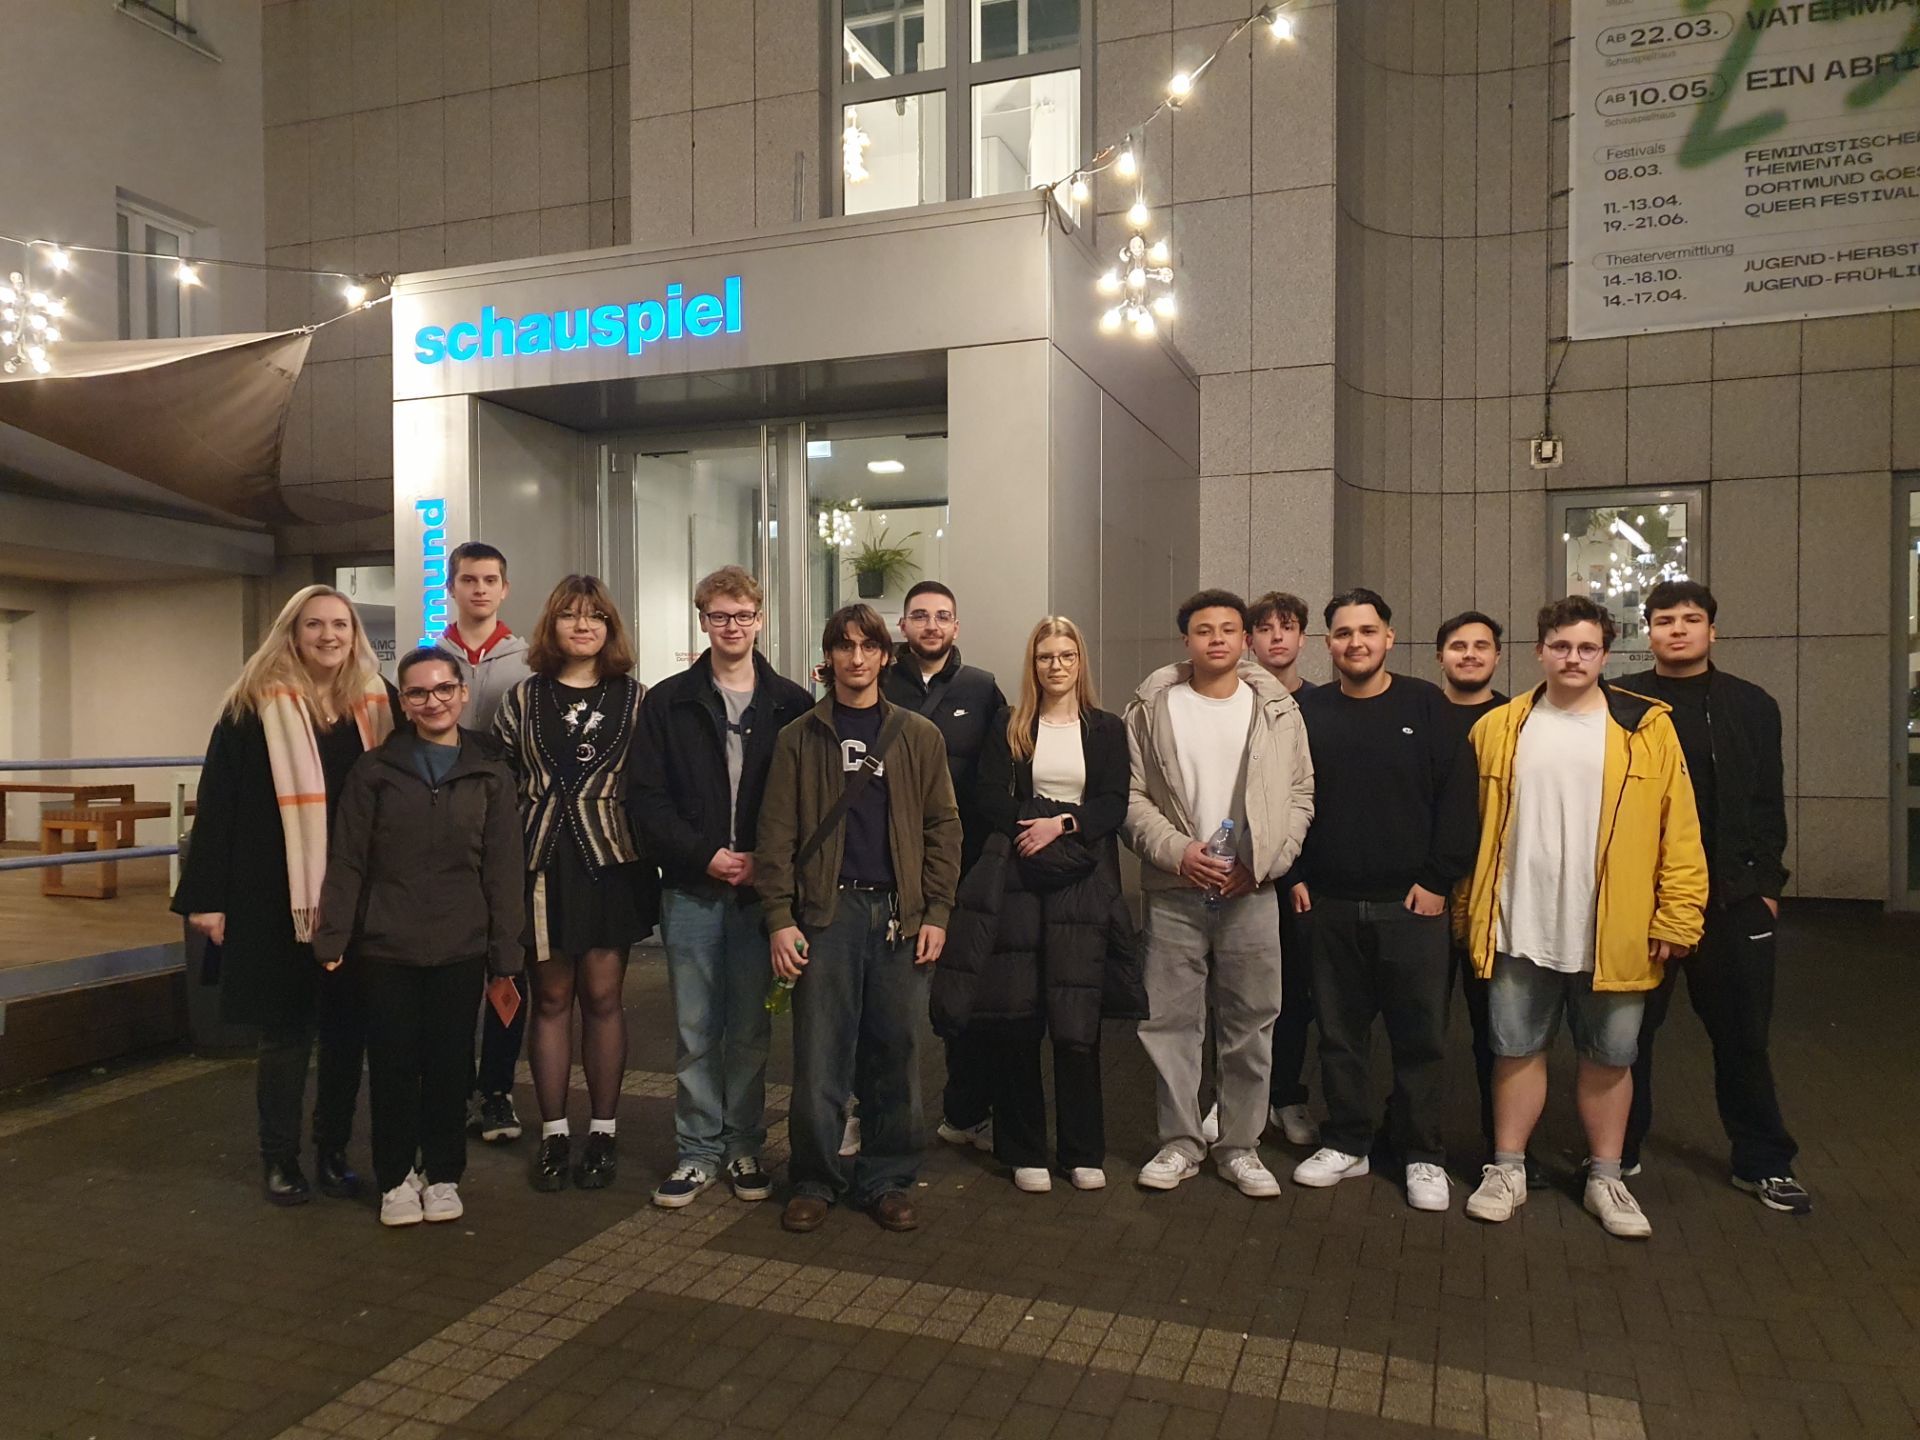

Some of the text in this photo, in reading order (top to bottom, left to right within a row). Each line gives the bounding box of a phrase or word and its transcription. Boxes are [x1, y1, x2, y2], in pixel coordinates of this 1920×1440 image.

[1606, 19, 1719, 47] AB 22.03.
[1747, 63, 1814, 91] EIN
[1604, 80, 1715, 107] AB 10.05.
[1607, 143, 1667, 160] Festivals
[1745, 131, 1920, 163] FEMINISTISCHE
[1604, 164, 1663, 181] 08.03.
[1745, 152, 1873, 178] THEMENTAG
[1746, 172, 1865, 197] DORTMUND
[1745, 186, 1919, 217] QUEER FESTIVAL
[1607, 243, 1734, 266] Theatervermittlung
[1603, 268, 1683, 287] 14.-18.10.
[1744, 265, 1920, 293] JUGEND-FRÜHLI
[1603, 289, 1687, 307] 14.-17.04.
[415, 275, 742, 364] schauspiel
